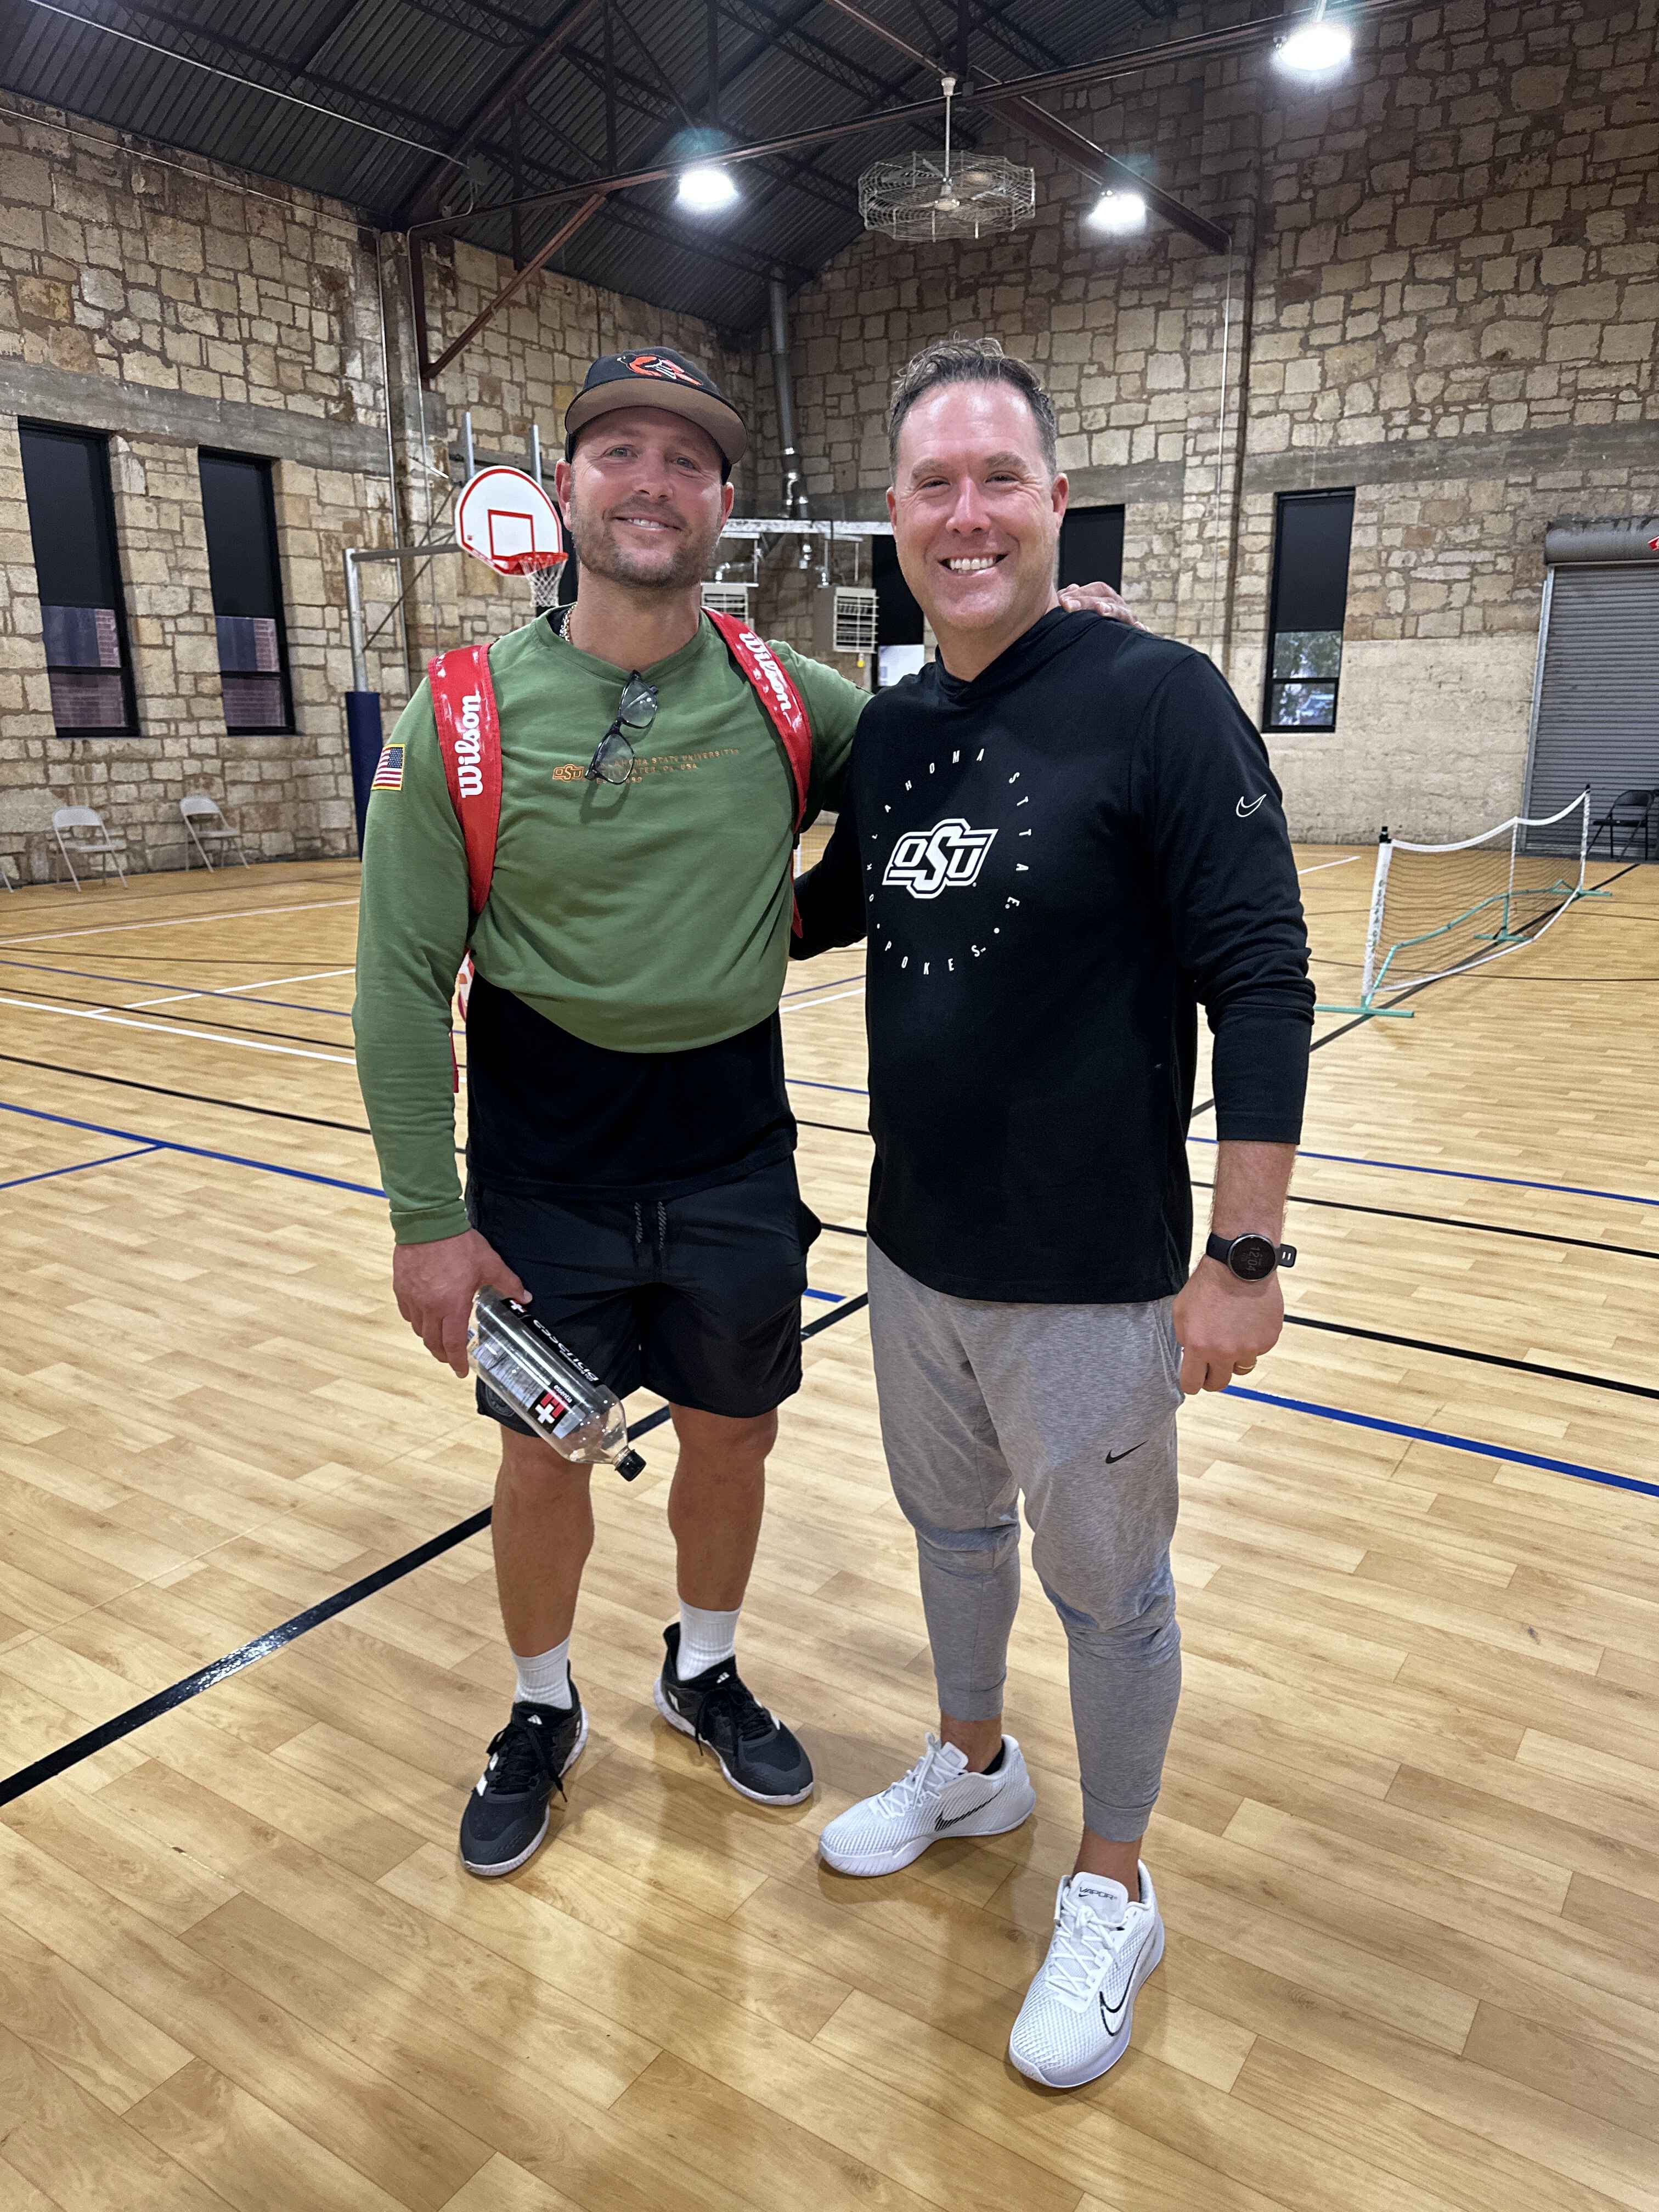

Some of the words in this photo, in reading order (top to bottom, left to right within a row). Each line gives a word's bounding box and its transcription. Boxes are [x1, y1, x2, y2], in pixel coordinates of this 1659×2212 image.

[739, 632, 791, 712] Wilson
[454, 689, 483, 798] Wilson
[866, 748, 984, 902] OKLAHOMA
[882, 818, 998, 899] OSU
[884, 940, 981, 975] POKES
